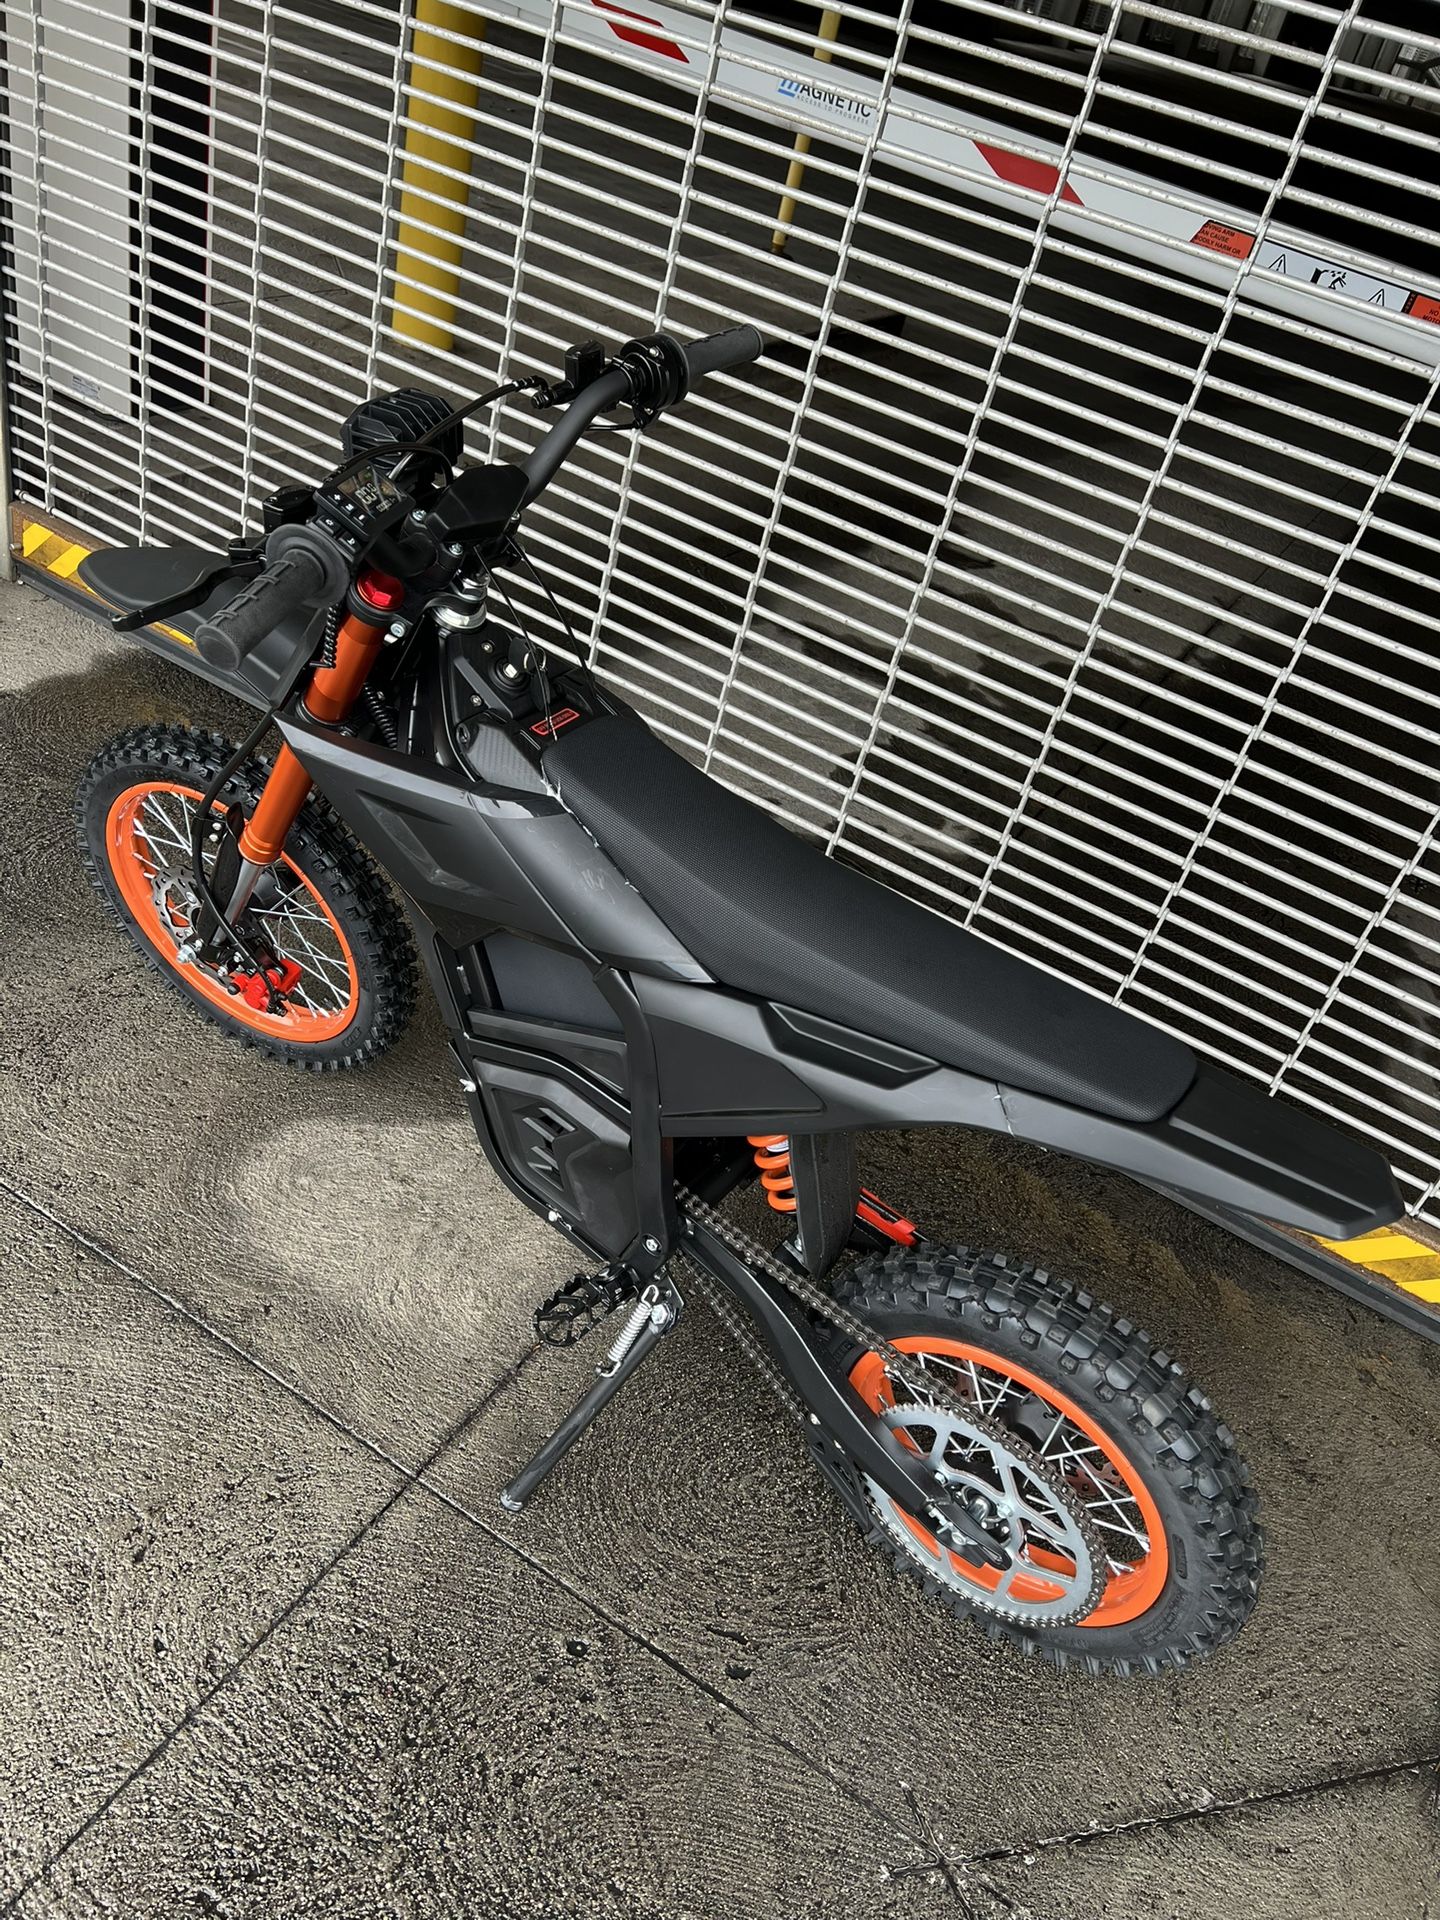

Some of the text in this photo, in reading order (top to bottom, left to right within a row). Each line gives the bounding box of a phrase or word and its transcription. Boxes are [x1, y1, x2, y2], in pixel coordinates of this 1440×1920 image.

[824, 104, 833, 112] TO
[1204, 222, 1222, 232] OVING
[1210, 232, 1230, 243] CAUSE
[1215, 241, 1231, 252] HARM
